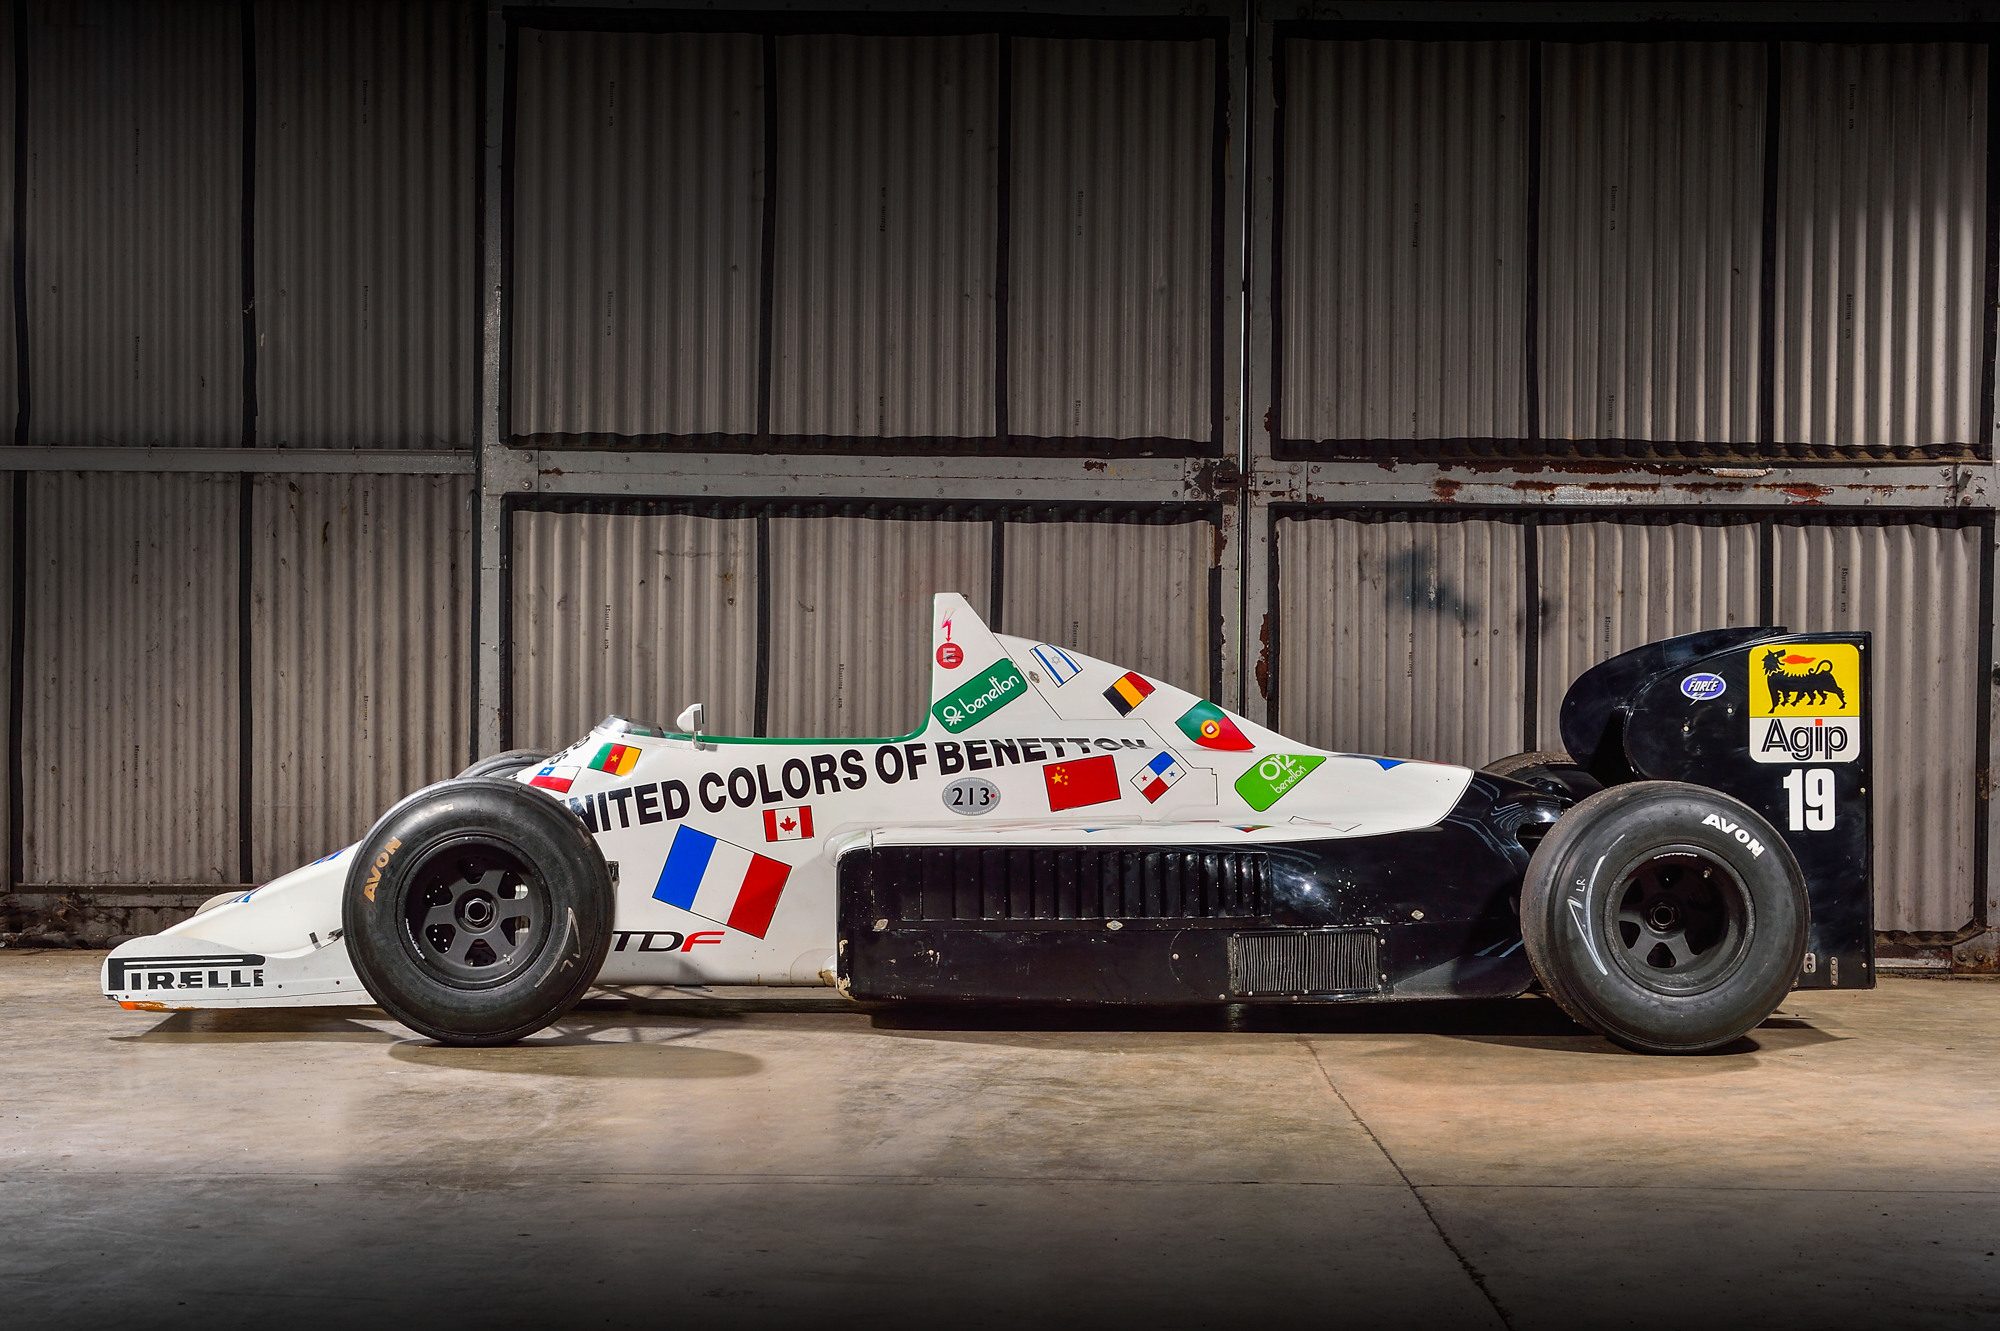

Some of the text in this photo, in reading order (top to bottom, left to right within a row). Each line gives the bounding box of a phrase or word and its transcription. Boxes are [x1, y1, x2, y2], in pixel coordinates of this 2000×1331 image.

[958, 675, 1020, 714] benetton
[1687, 680, 1720, 692] FORCE
[1760, 718, 1848, 761] Agip
[560, 738, 1153, 833] NITED COLORS OF BENETTON
[952, 787, 990, 806] 213
[1269, 764, 1308, 794] benetton
[1782, 768, 1836, 831] 19
[1701, 813, 1766, 858] AVON
[363, 836, 402, 903] AVON
[1575, 878, 1587, 893] LR
[613, 930, 725, 952] TDF
[108, 953, 266, 991] PIRELLI
